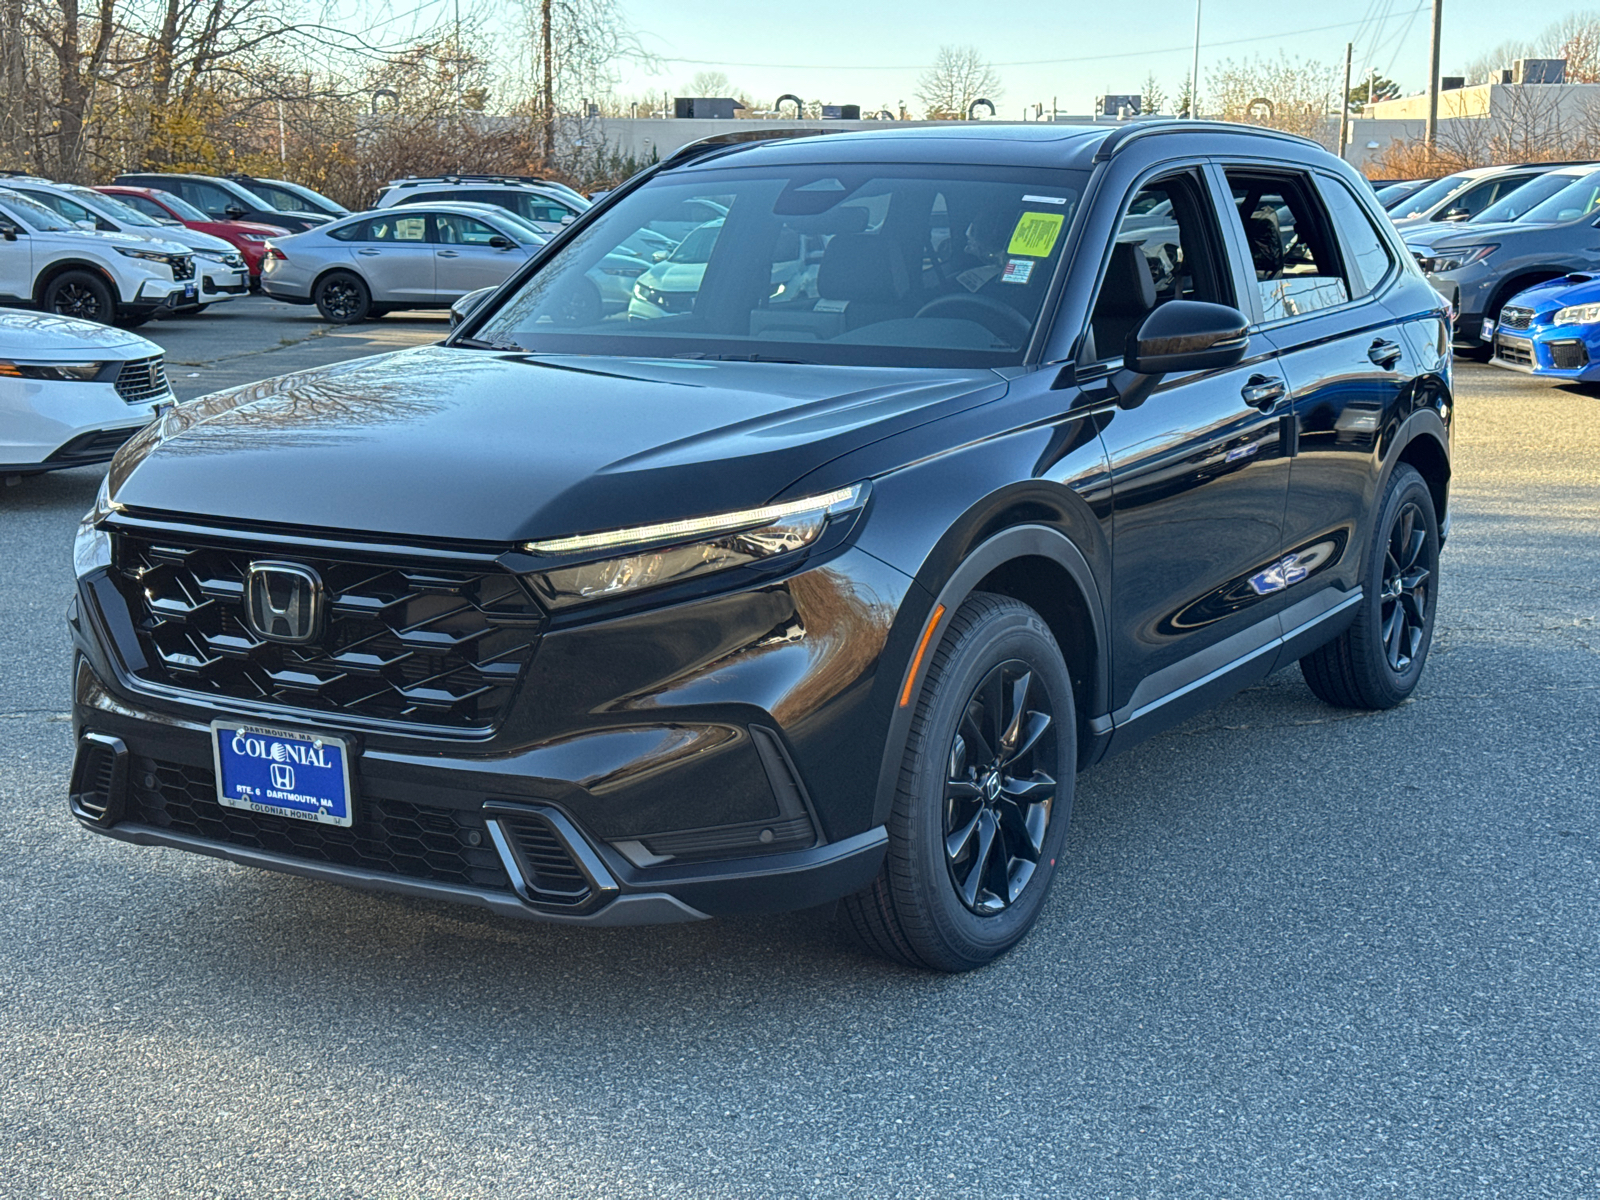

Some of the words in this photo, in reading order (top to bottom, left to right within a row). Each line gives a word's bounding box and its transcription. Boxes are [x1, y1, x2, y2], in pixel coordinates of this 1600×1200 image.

[299, 733, 312, 741] MA
[231, 736, 332, 768] COLONIAL
[236, 784, 254, 795] RTE.
[255, 787, 261, 796] 6
[266, 789, 319, 806] DARTMOUTH,
[320, 798, 333, 808] MA
[250, 803, 288, 817] COLONIAL
[290, 810, 319, 821] HONDA
